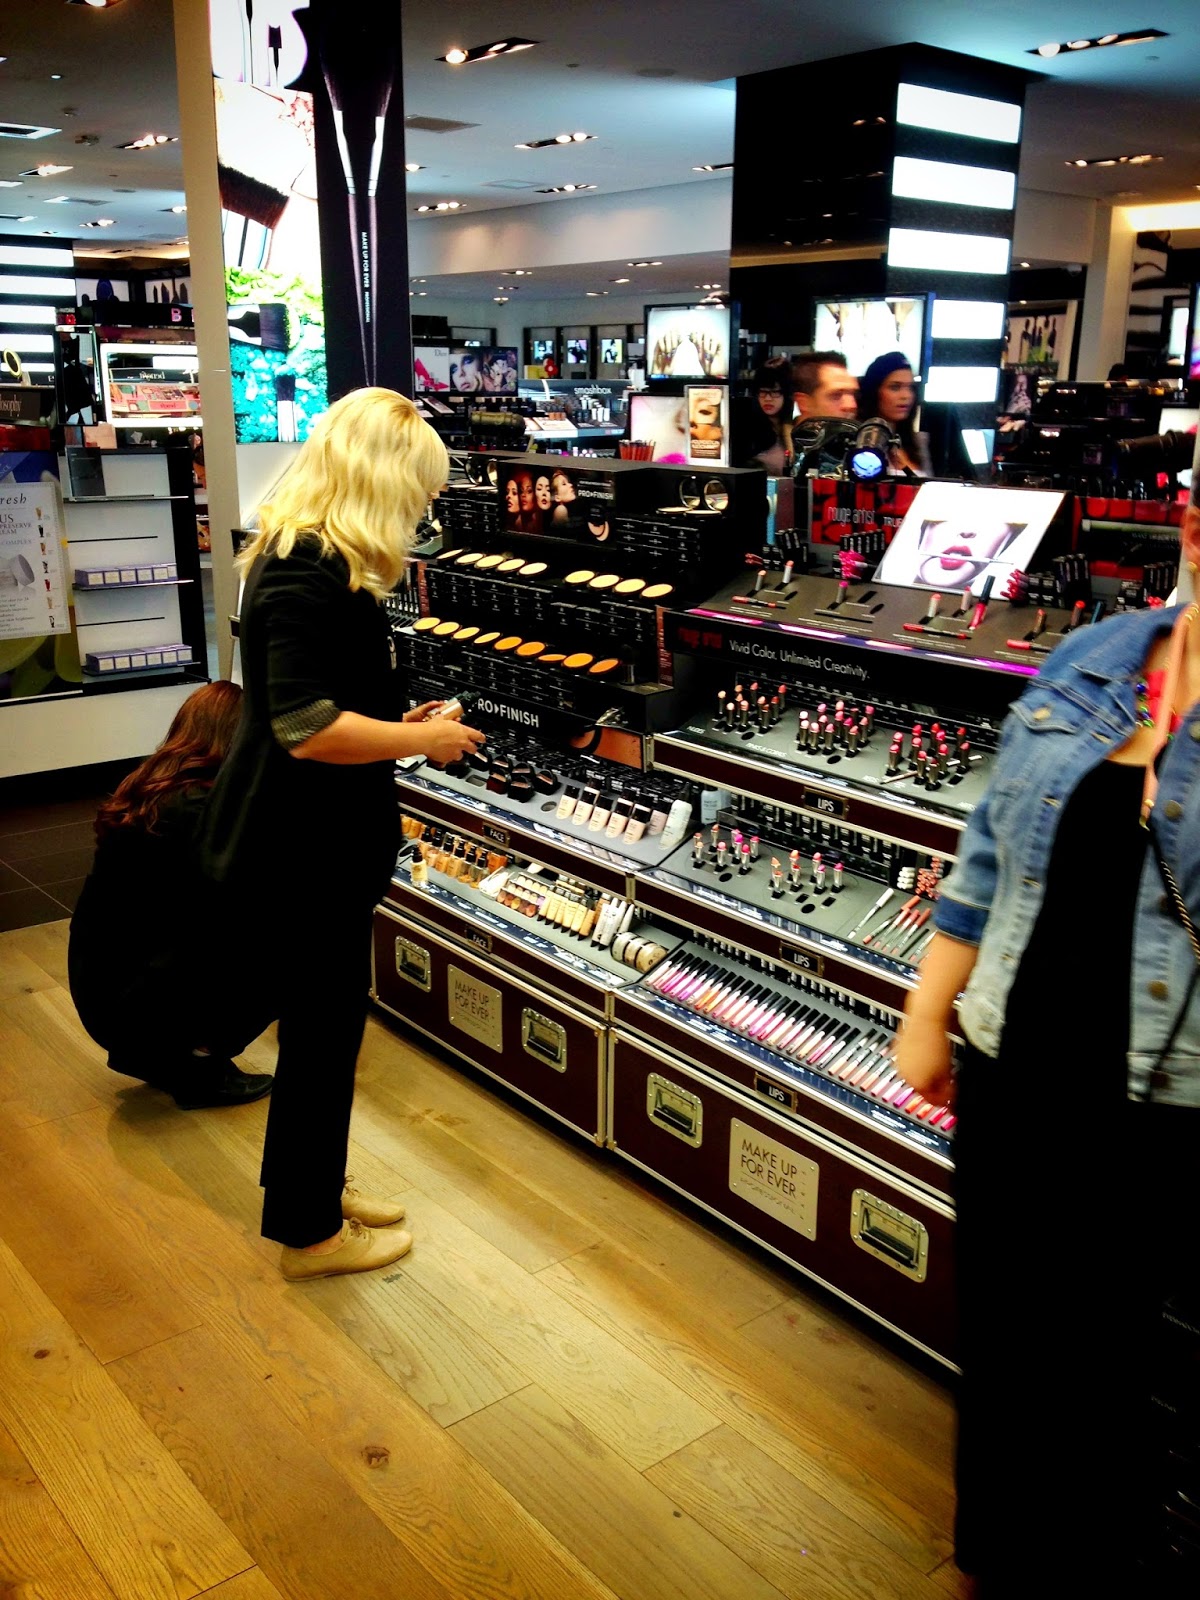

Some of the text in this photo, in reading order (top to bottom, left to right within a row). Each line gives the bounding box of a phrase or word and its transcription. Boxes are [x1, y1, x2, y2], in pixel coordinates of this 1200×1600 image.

[362, 250, 368, 259] UP
[574, 384, 612, 394] smashbox
[828, 506, 851, 526] rouge
[728, 640, 870, 681] Vivid Color. Unlimited Creativity.
[500, 704, 539, 728] FINISH
[817, 798, 835, 813] LIPS
[489, 829, 504, 842] FACE
[473, 934, 487, 948] FACE
[794, 953, 810, 968] LIPS
[455, 980, 489, 1006] MAKE UP
[455, 992, 490, 1022] FOR EVER
[768, 1086, 785, 1101] LIPS
[742, 1139, 798, 1178] MAKE UP
[741, 1154, 796, 1199] FOR EVER
